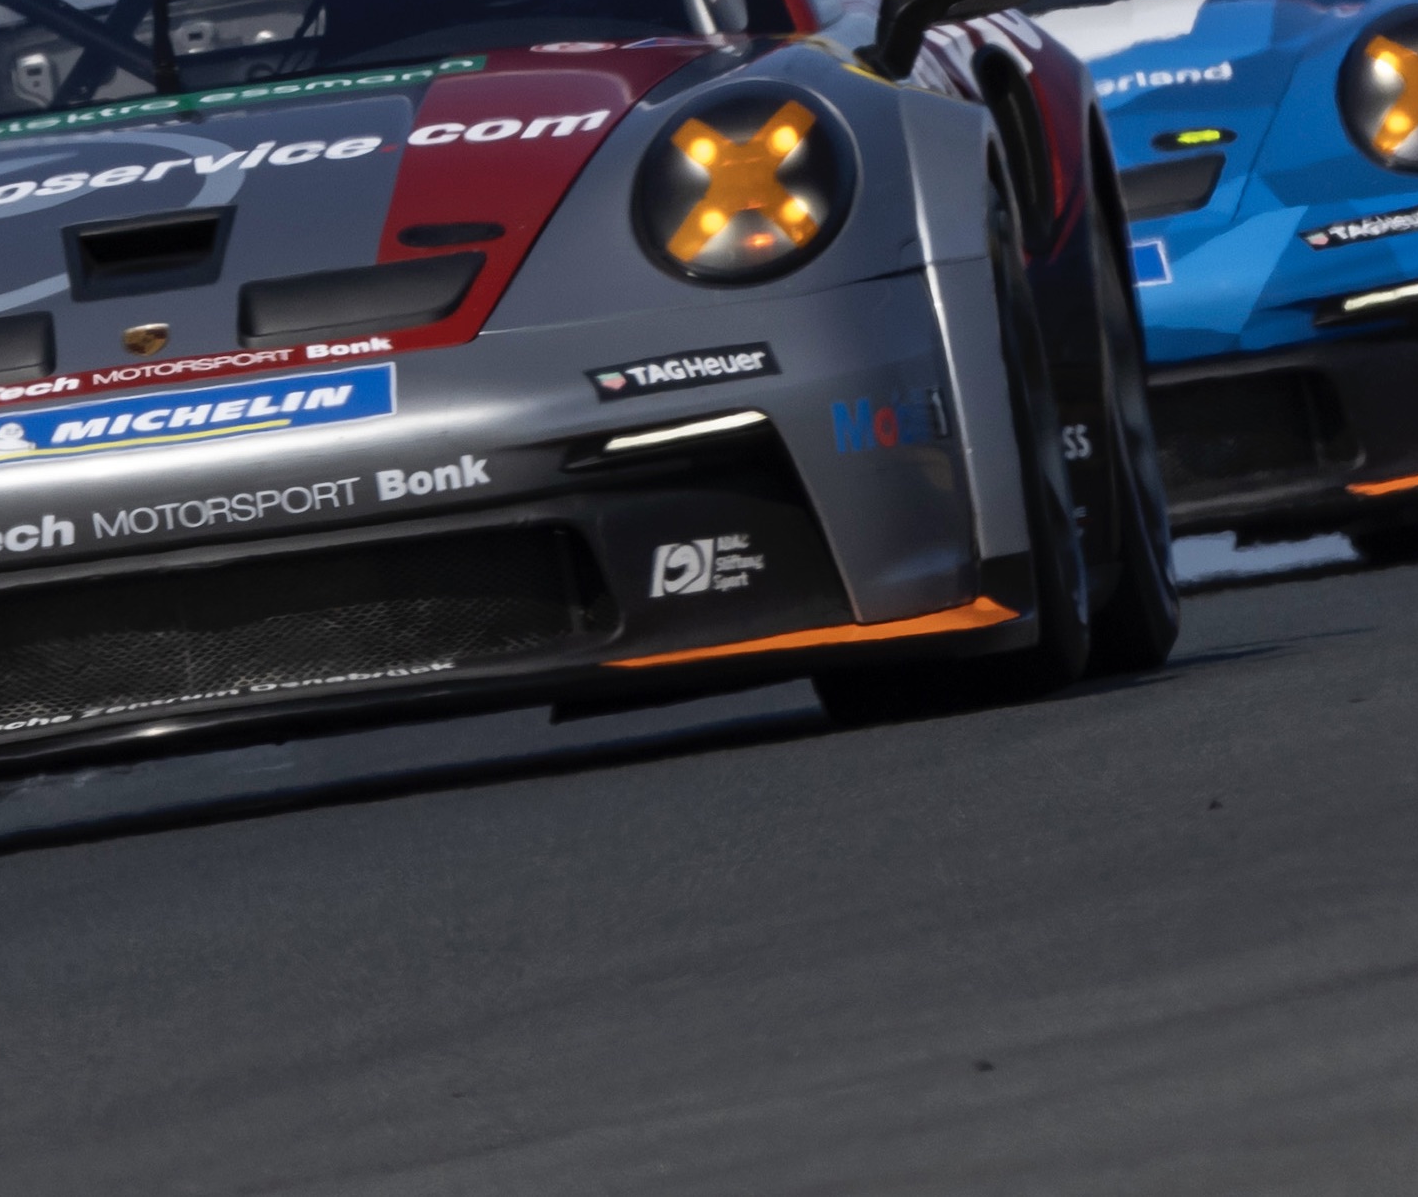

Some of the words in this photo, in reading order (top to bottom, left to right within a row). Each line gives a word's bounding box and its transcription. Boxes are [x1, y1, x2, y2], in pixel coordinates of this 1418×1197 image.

[199, 59, 474, 103] essmann
[93, 348, 295, 385] MOTORSPORT
[306, 335, 393, 361] Bonk
[51, 385, 353, 445] MICHELIN
[93, 477, 361, 540] MOTORSPORT
[377, 454, 491, 502] Bonk
